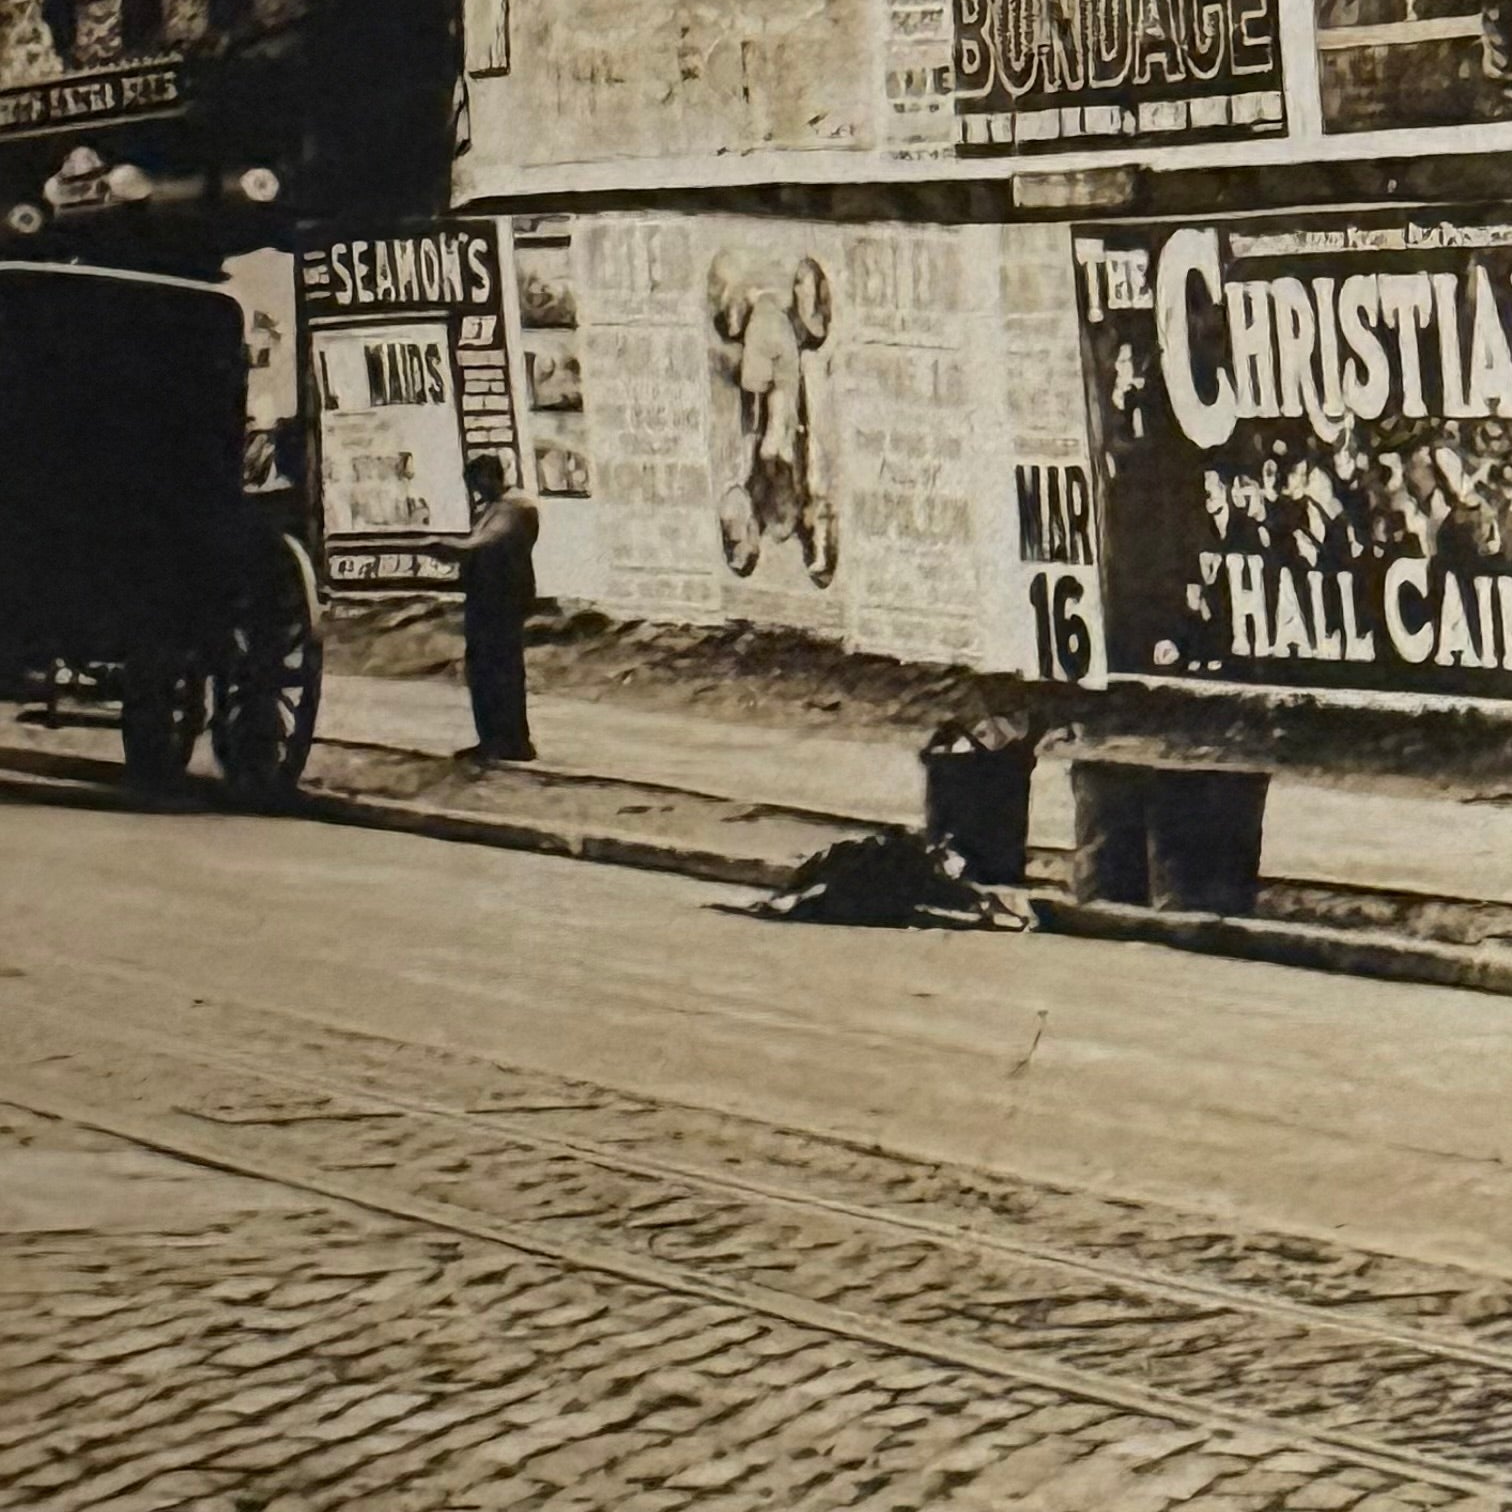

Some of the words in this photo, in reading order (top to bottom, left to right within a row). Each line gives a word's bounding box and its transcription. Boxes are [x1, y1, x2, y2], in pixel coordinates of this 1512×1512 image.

[1074, 238, 1154, 323] THE
[1016, 464, 1094, 566] MAR
[1029, 571, 1093, 682] 16
[1223, 552, 1376, 663] HALL
